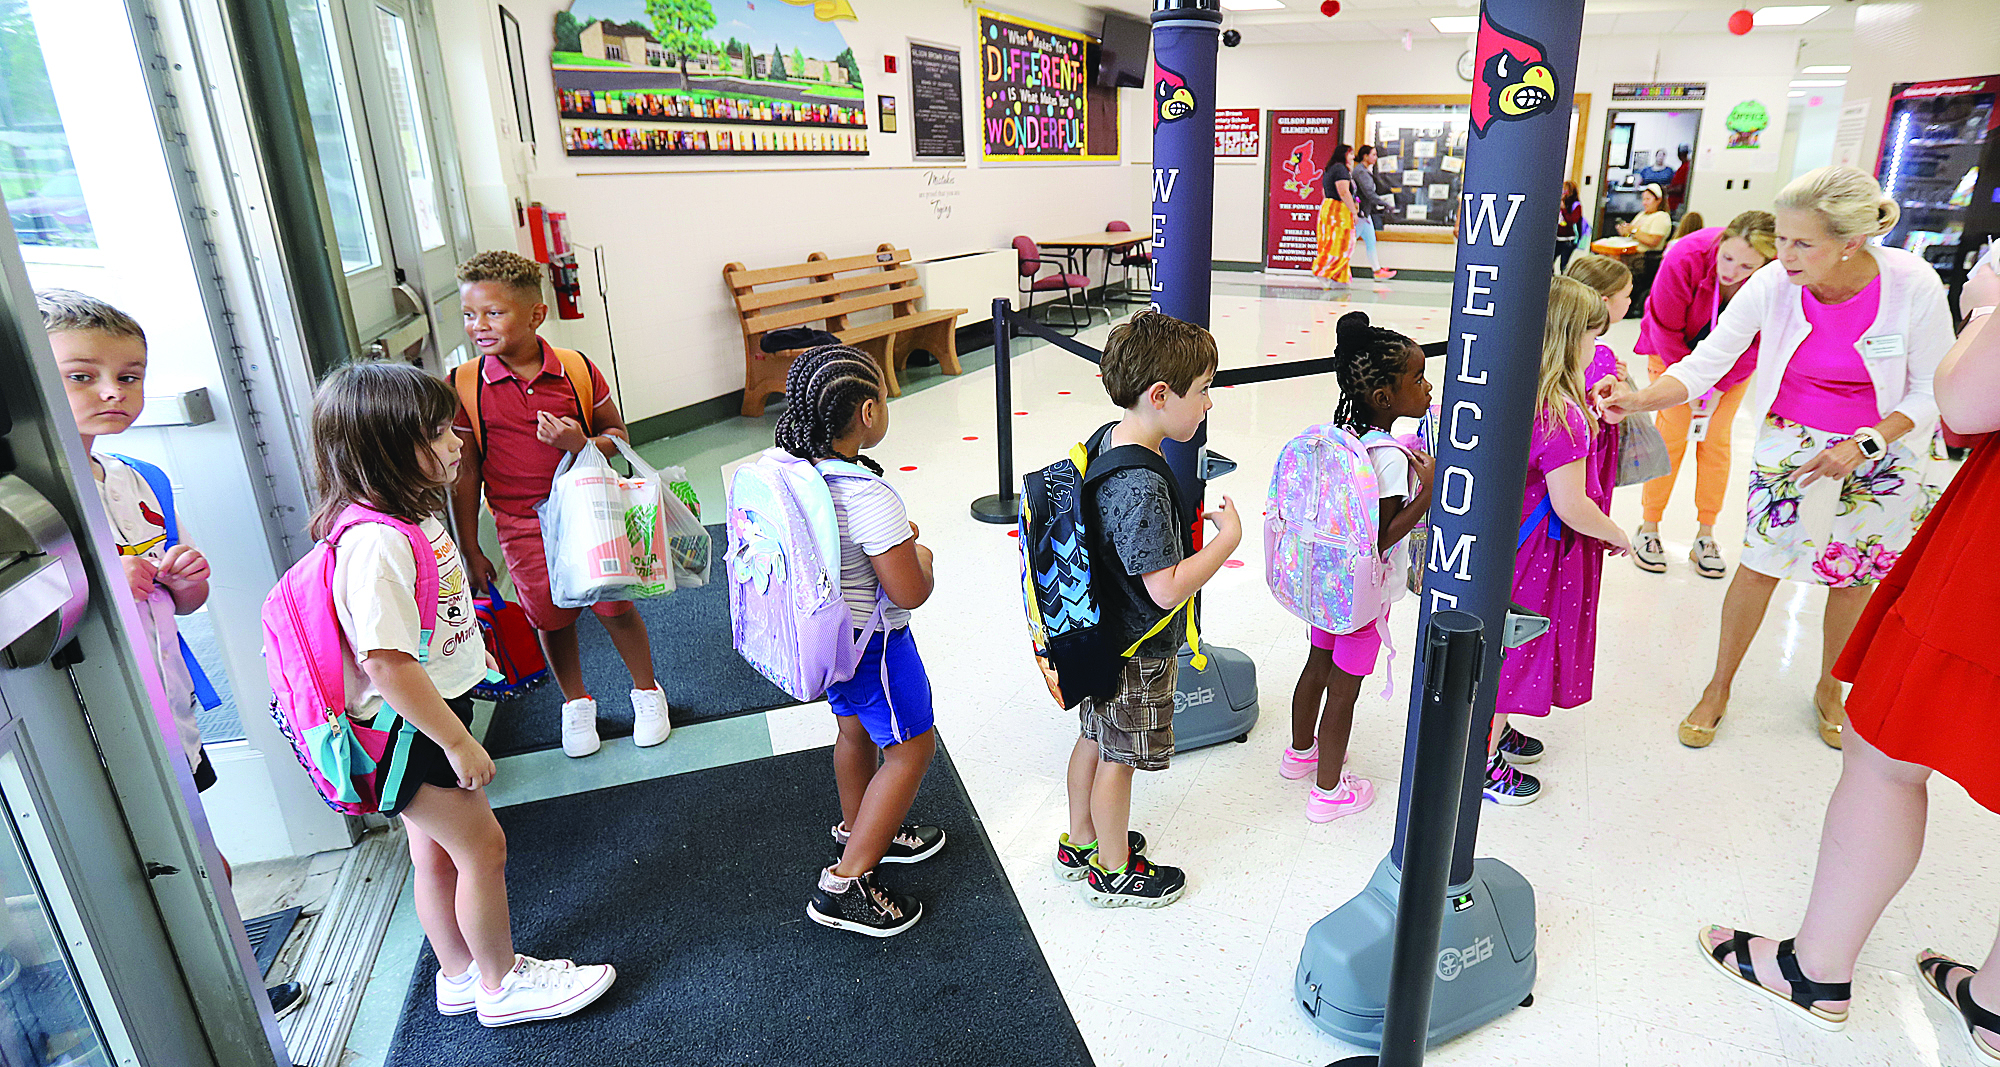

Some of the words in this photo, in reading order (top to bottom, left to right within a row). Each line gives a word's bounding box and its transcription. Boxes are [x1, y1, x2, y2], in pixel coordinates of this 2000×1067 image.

[1008, 29, 1028, 46] What
[1032, 36, 1052, 52] Makes
[1055, 40, 1067, 54] You
[986, 44, 1080, 92] DIFFERENT
[1007, 86, 1017, 101] IS
[1019, 88, 1039, 104] What
[1040, 91, 1058, 106] Makes
[1058, 94, 1069, 107] You
[1278, 117, 1305, 125] GILSON
[1306, 117, 1334, 125] BROWN
[1281, 126, 1330, 134] ELEMENTARY
[986, 116, 1083, 149] WONDERFUL
[1291, 212, 1312, 221] YET
